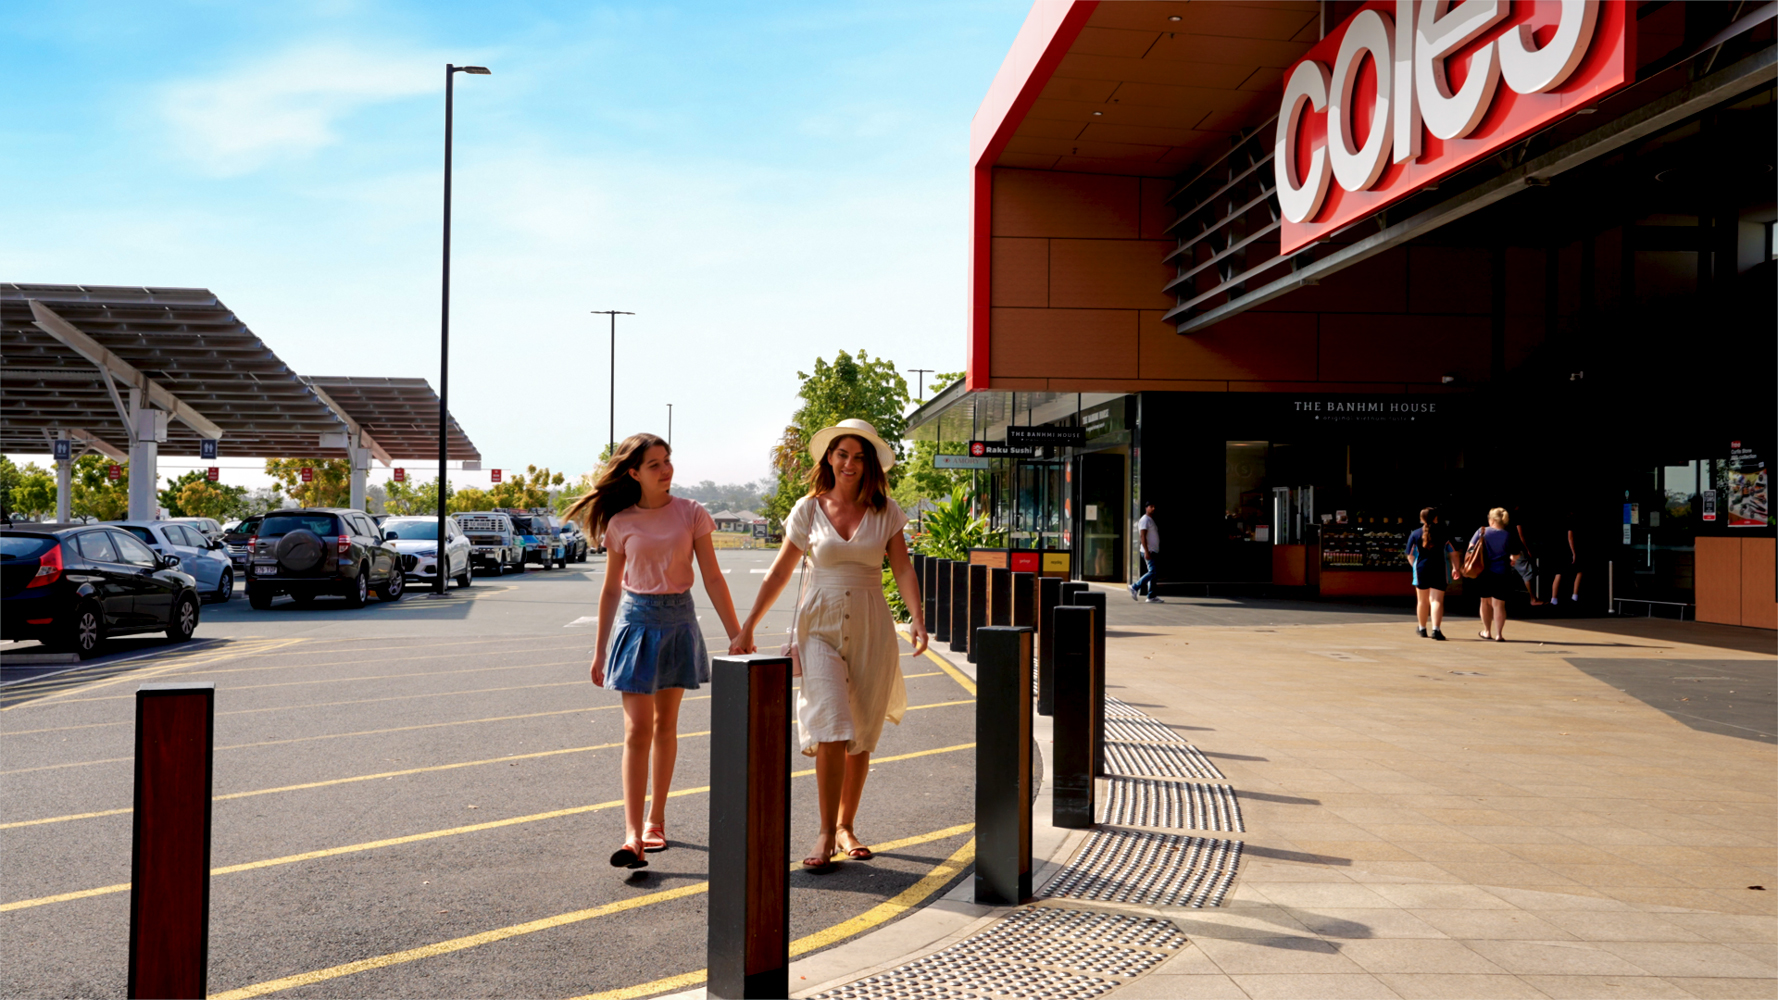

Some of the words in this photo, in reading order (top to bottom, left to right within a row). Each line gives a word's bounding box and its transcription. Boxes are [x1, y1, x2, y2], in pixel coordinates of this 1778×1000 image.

[1294, 401, 1322, 411] THE
[1327, 402, 1384, 412] BANHMI
[1390, 403, 1437, 413] HOUSE
[986, 446, 1008, 454] Raku
[1010, 446, 1033, 454] Sushi
